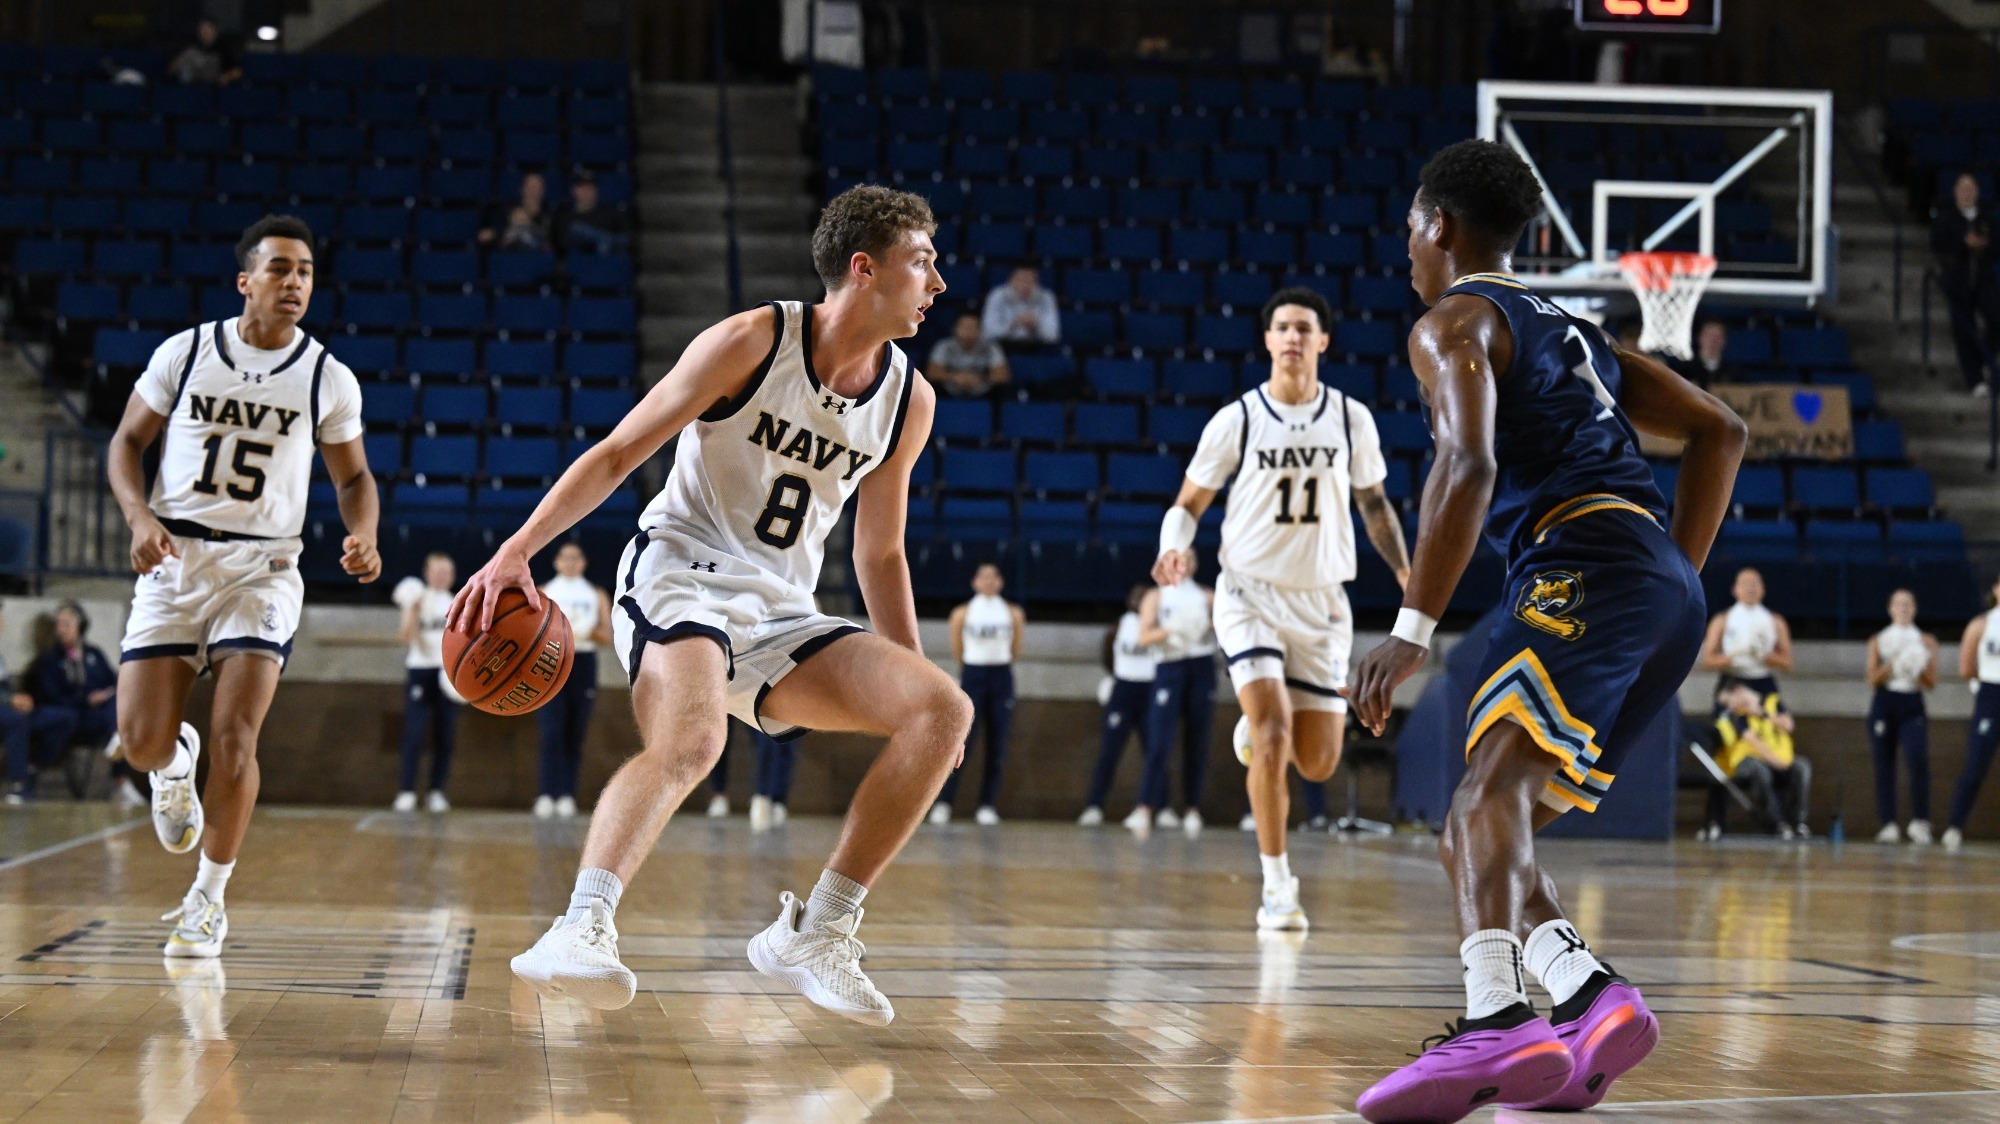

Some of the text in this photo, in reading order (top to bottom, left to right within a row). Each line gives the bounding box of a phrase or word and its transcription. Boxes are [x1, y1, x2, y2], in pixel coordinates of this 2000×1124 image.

[190, 394, 301, 437] NAVY
[192, 432, 275, 503] 15
[747, 409, 873, 481] NAVY
[1257, 446, 1339, 470] NAVY
[753, 470, 812, 550] 8
[1274, 476, 1320, 524] 11
[530, 640, 561, 683] THE
